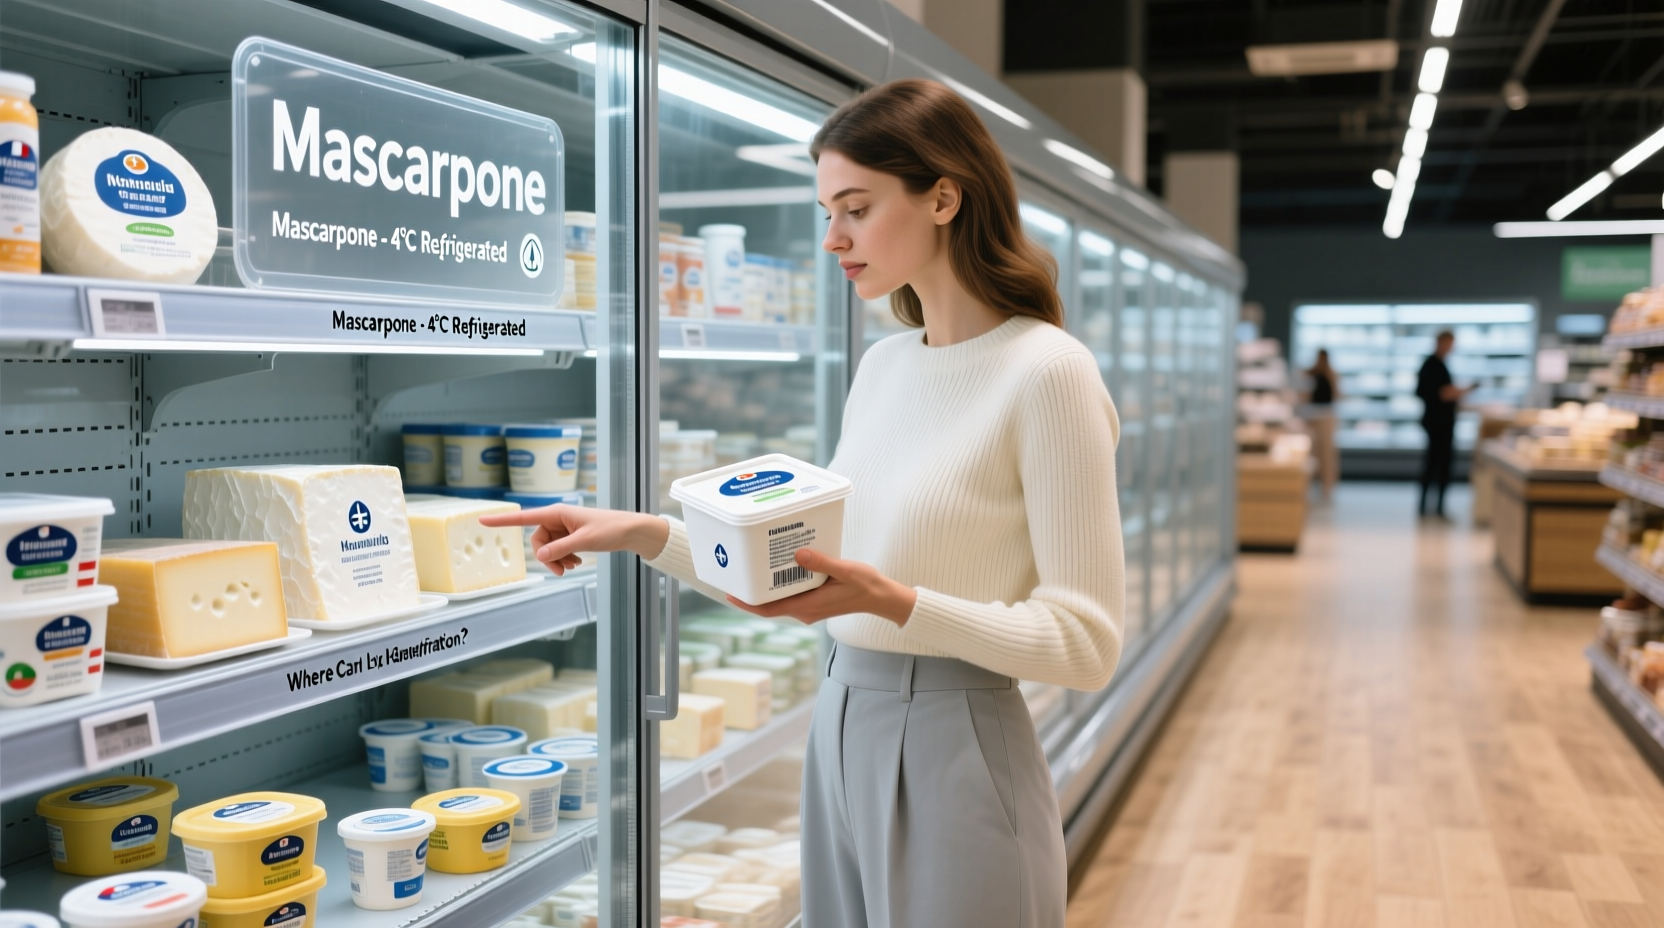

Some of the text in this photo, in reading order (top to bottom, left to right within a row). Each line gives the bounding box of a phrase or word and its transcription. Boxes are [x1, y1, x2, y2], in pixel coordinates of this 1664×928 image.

[273, 98, 547, 218] Mascarpone
[272, 210, 378, 251] Mascarpone
[421, 230, 508, 263] Refrigerated
[332, 310, 417, 339] Mascarpone
[287, 667, 334, 692] Where
